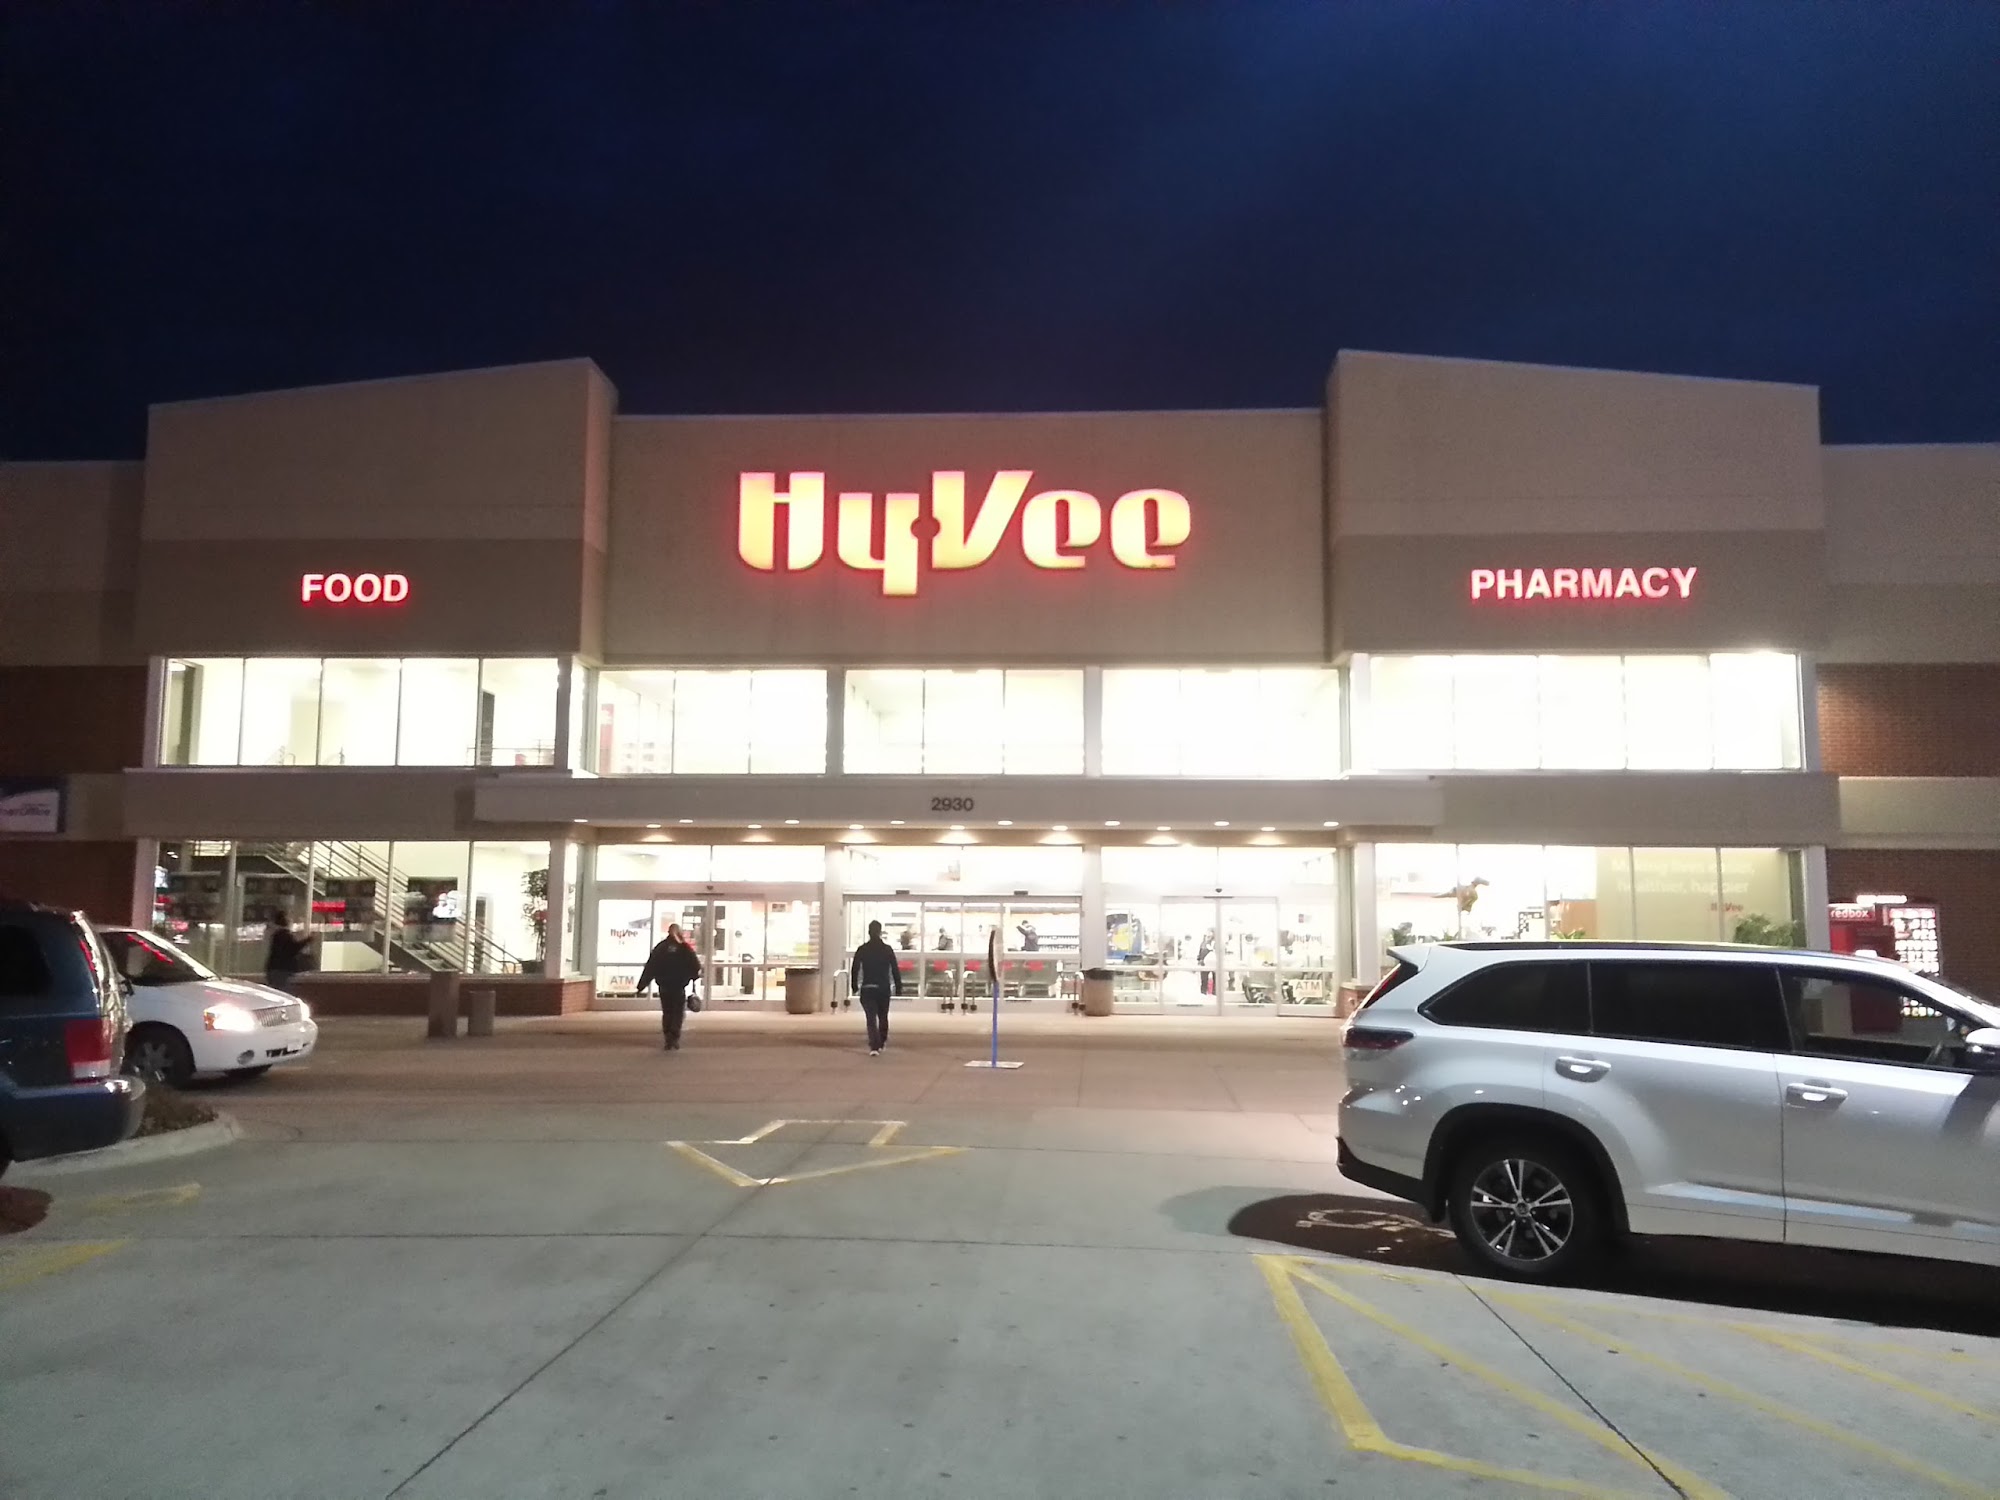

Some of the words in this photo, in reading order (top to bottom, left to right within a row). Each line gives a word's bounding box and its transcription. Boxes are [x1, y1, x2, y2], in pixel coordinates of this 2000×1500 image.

[302, 573, 408, 602] FOOD
[1471, 567, 1697, 599] PHARMACY
[931, 797, 974, 811] 2930
[1830, 908, 1869, 918] redbox
[610, 976, 635, 985] ATM
[1295, 981, 1320, 990] ATM
